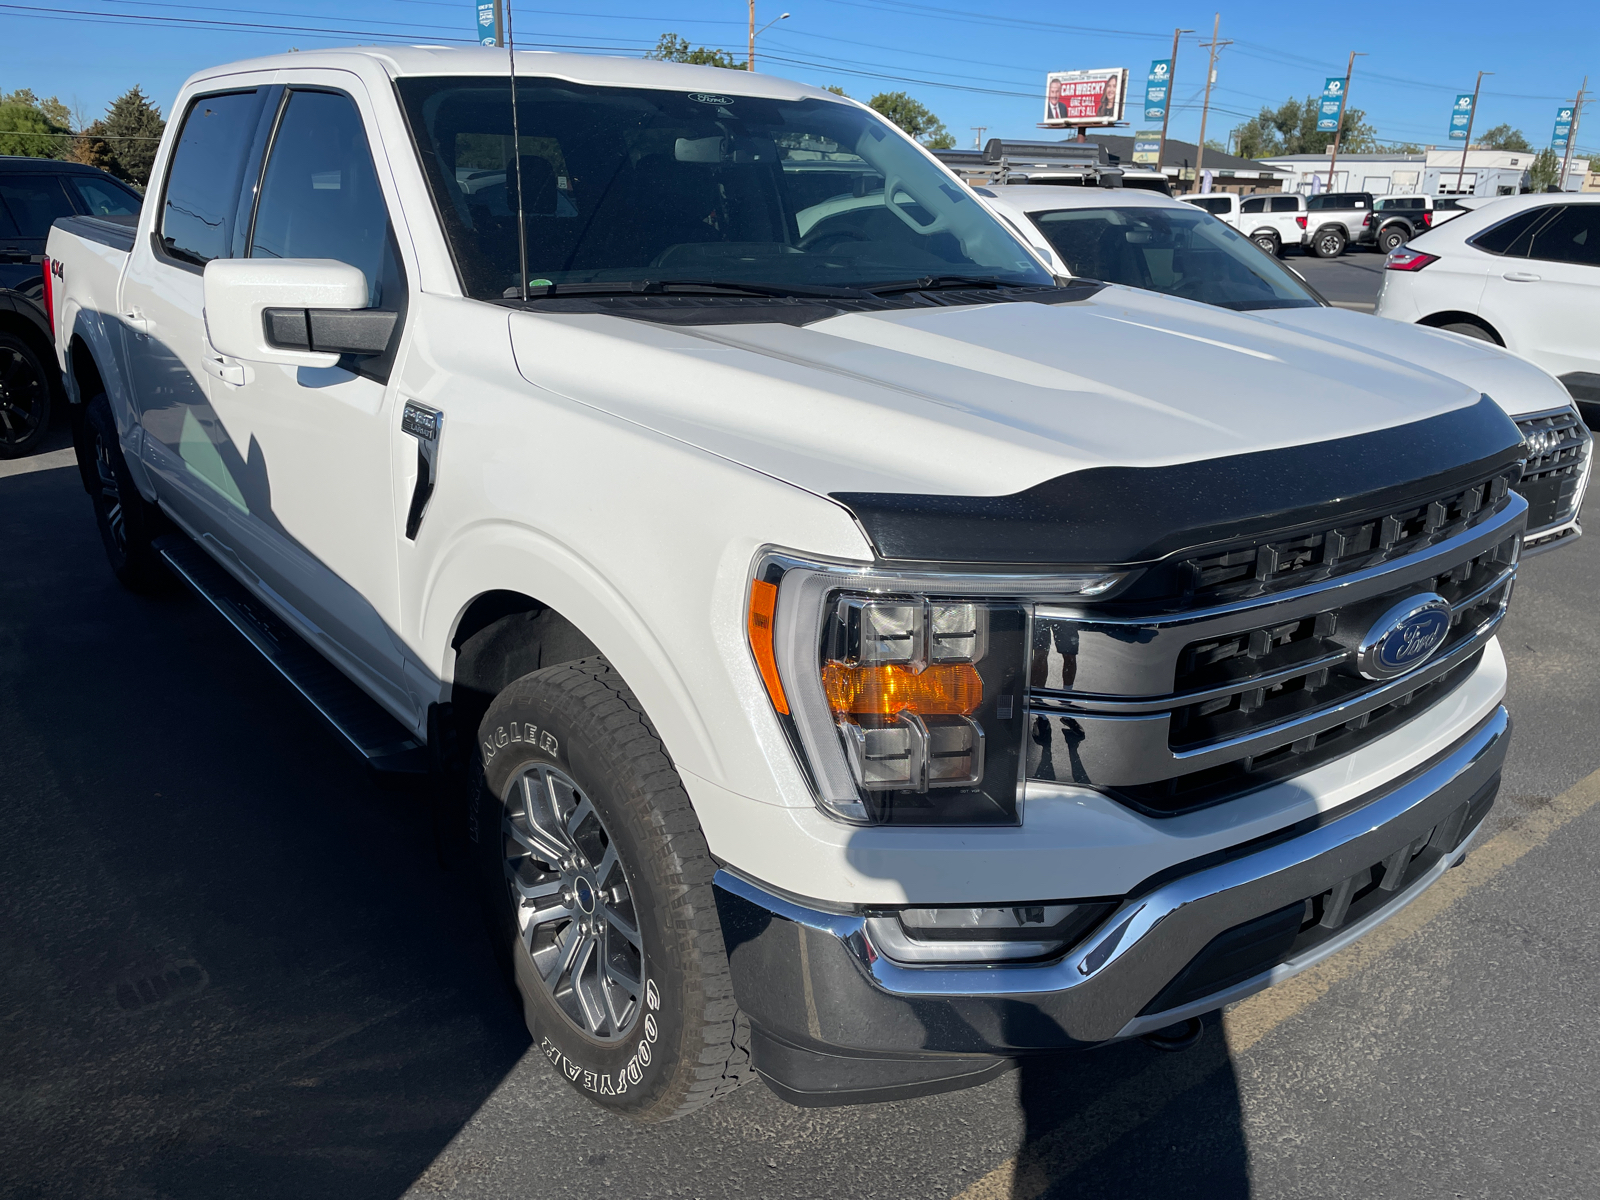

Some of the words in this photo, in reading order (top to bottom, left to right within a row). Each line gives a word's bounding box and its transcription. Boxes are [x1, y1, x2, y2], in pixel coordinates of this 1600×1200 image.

[1061, 84, 1075, 96] CAR
[1076, 82, 1105, 95] WRECK?
[697, 93, 727, 103] Ford
[1070, 97, 1080, 106] ONE
[1082, 96, 1095, 106] CALL
[1068, 107, 1085, 116] THAT'S
[1086, 106, 1096, 115] ALL
[1396, 619, 1440, 661] Ford
[541, 978, 660, 1095] GOODYEAR
